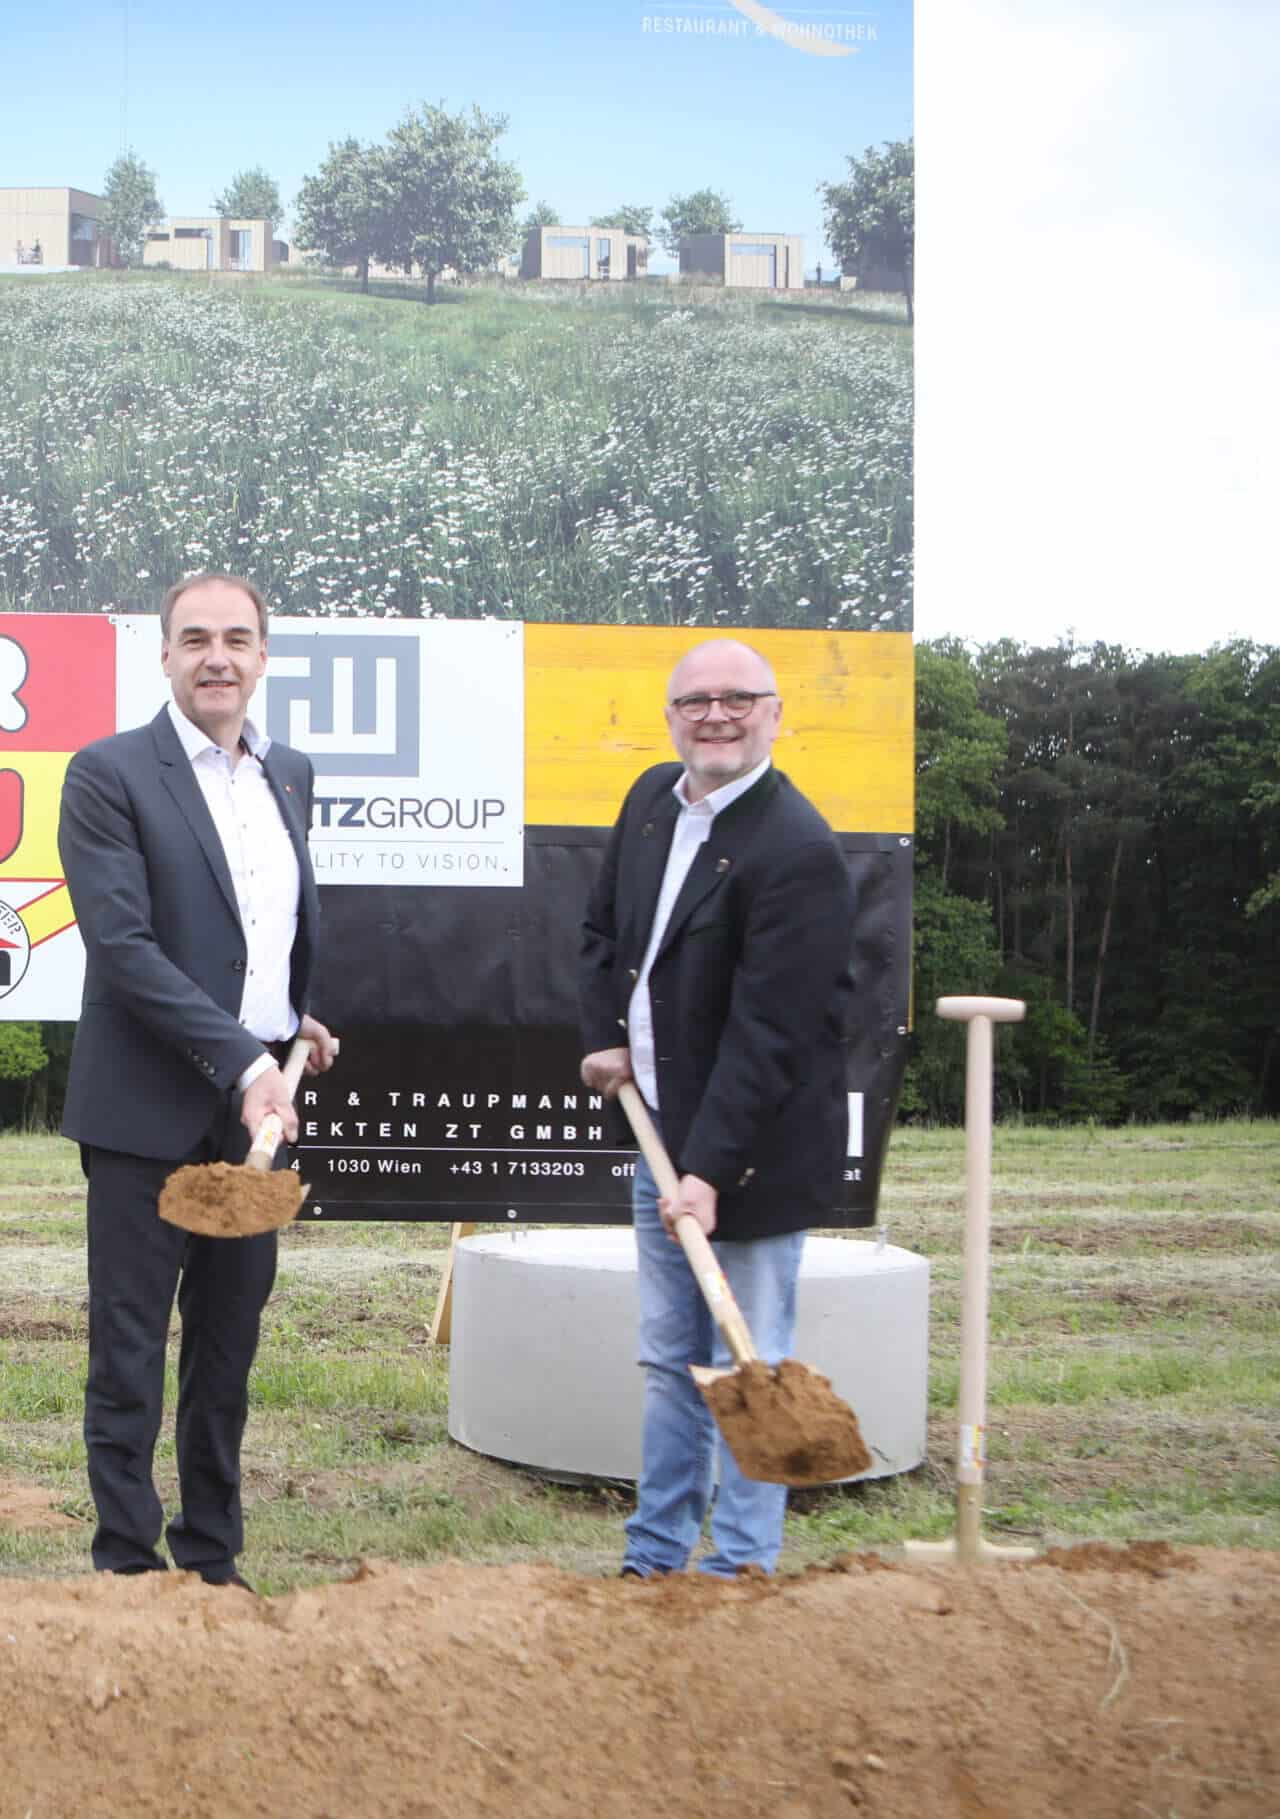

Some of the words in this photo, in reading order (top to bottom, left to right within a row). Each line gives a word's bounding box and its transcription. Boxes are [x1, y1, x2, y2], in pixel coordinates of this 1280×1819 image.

[642, 16, 748, 34] RESTAURANT
[376, 852, 405, 870] TO
[347, 1091, 362, 1106] &
[388, 1092, 603, 1110] TRAUPMANN
[445, 1123, 483, 1139] ZT
[509, 1124, 603, 1141] GMBH
[327, 1159, 370, 1173] 1030
[377, 1159, 422, 1174] Wien
[449, 1160, 483, 1175] +43
[491, 1161, 499, 1175] 1
[508, 1161, 586, 1176] 7133203
